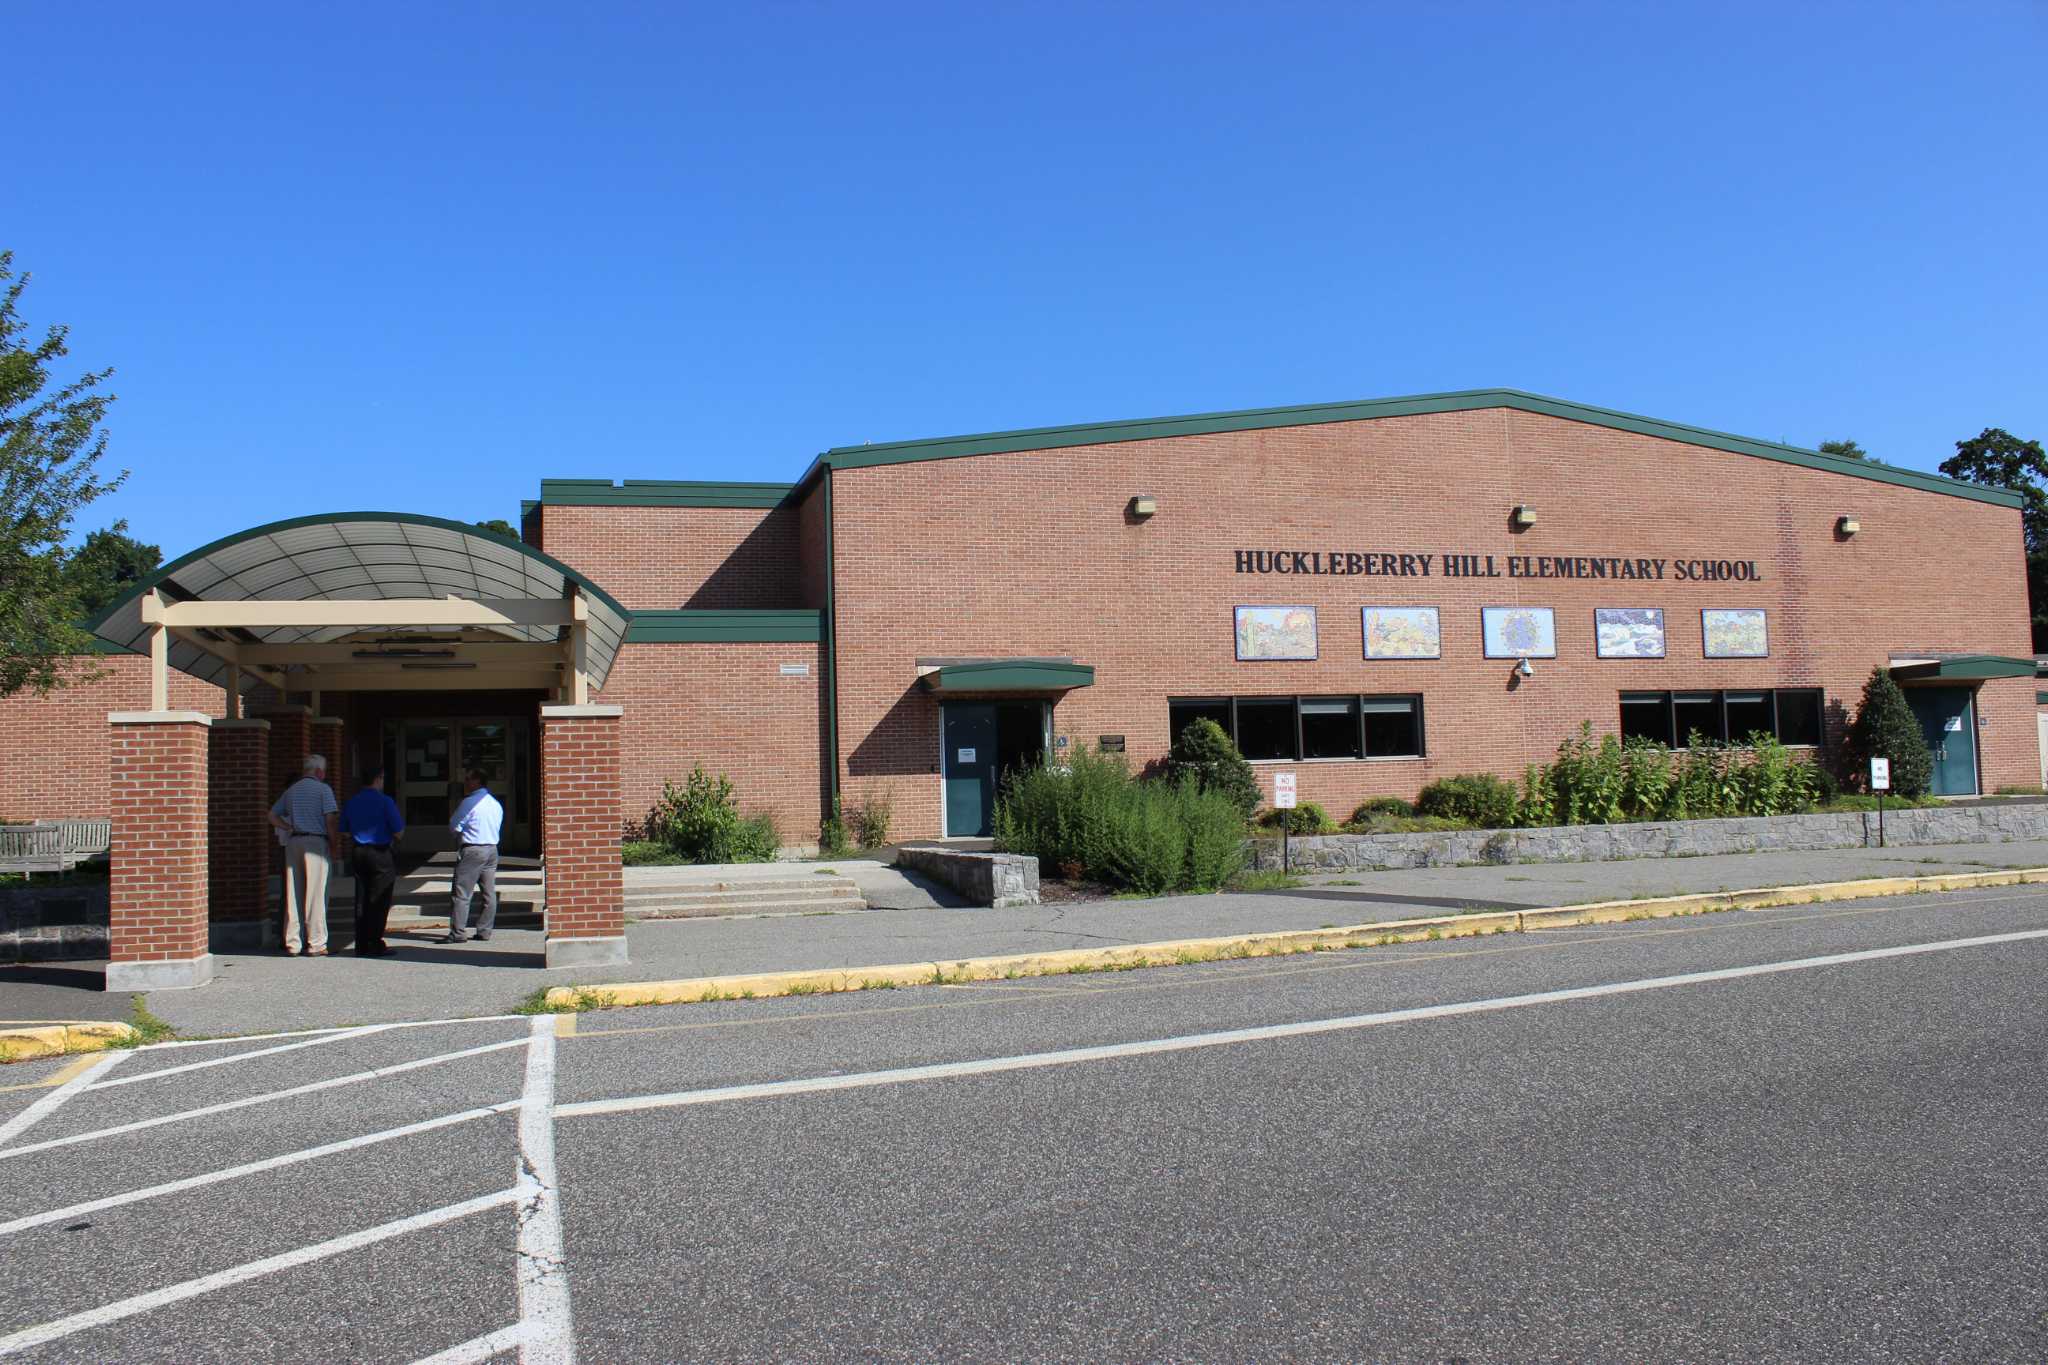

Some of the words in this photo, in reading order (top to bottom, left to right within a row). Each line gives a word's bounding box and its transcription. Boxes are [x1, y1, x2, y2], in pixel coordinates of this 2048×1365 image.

[1234, 550, 1433, 576] HUCKLEBERRY
[1443, 554, 1500, 578] HILL
[1507, 556, 1666, 580] ELEMENTARY
[1674, 559, 1761, 582] SCHOOL
